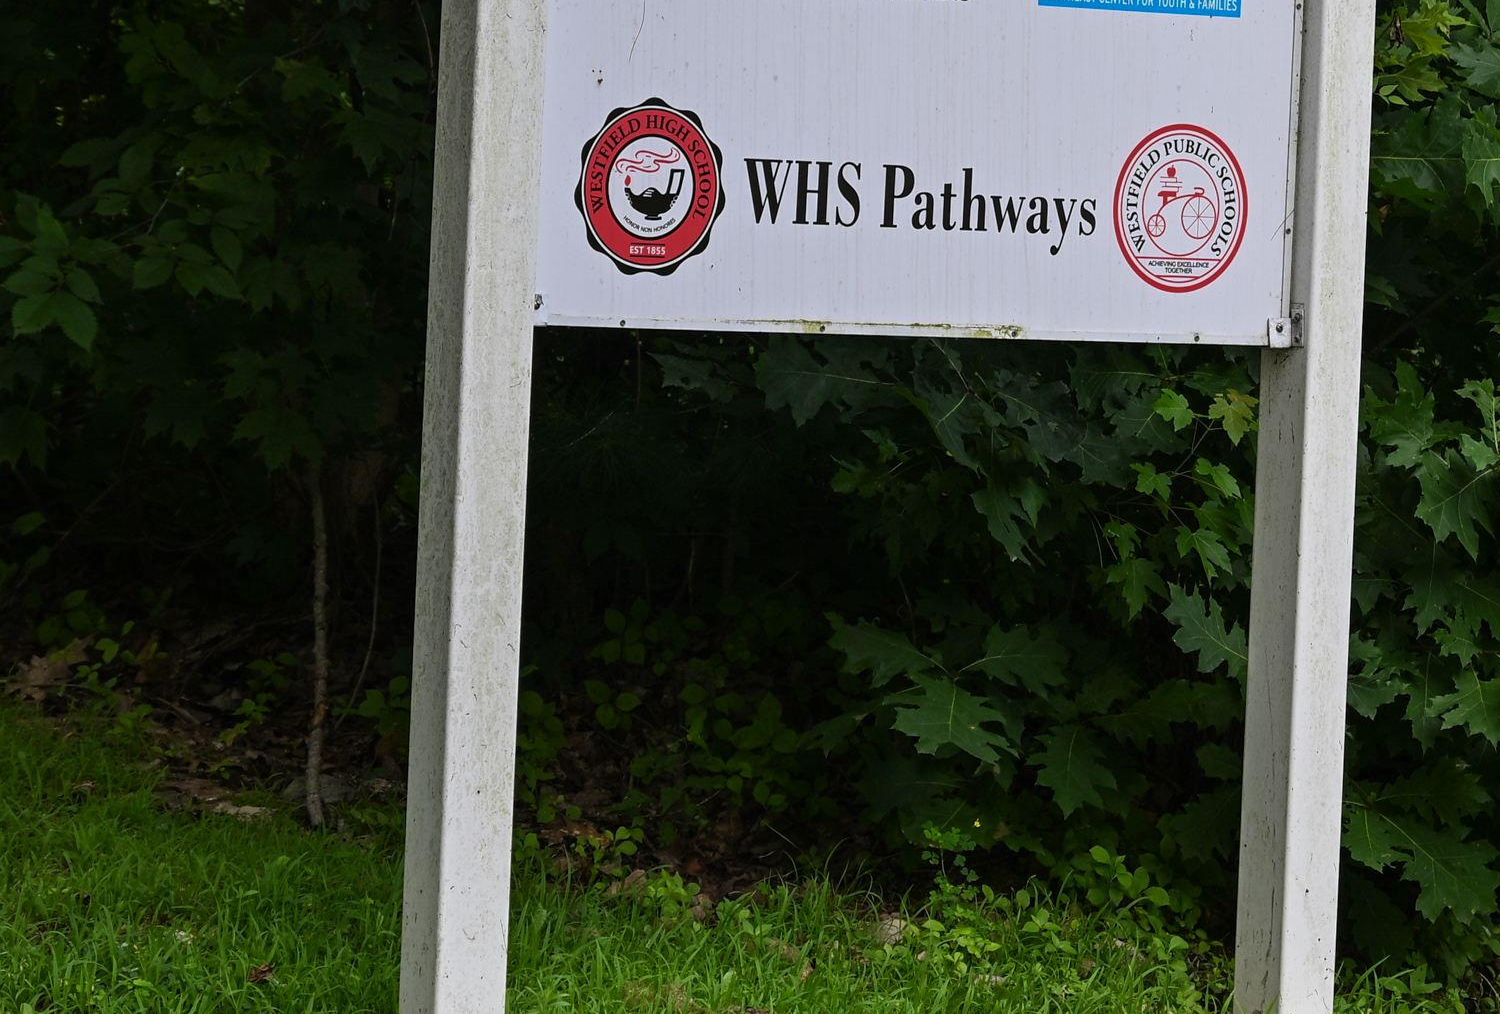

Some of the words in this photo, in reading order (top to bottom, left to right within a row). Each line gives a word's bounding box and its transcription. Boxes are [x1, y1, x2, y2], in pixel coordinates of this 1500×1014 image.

[590, 118, 641, 214] WESTFIELD
[646, 114, 690, 143] HIGH
[687, 139, 711, 220] SCHOOL
[744, 158, 861, 227] WHS
[880, 163, 1097, 256] Pathways
[1126, 149, 1160, 253] WESTFIELD
[1163, 138, 1220, 168] PUBLIC
[1211, 166, 1236, 257] SCHOOLS
[629, 245, 644, 255] EST
[647, 245, 666, 256] 1855
[1148, 260, 1176, 268] ACHIEVING
[1177, 261, 1209, 269] EXCELLENCE
